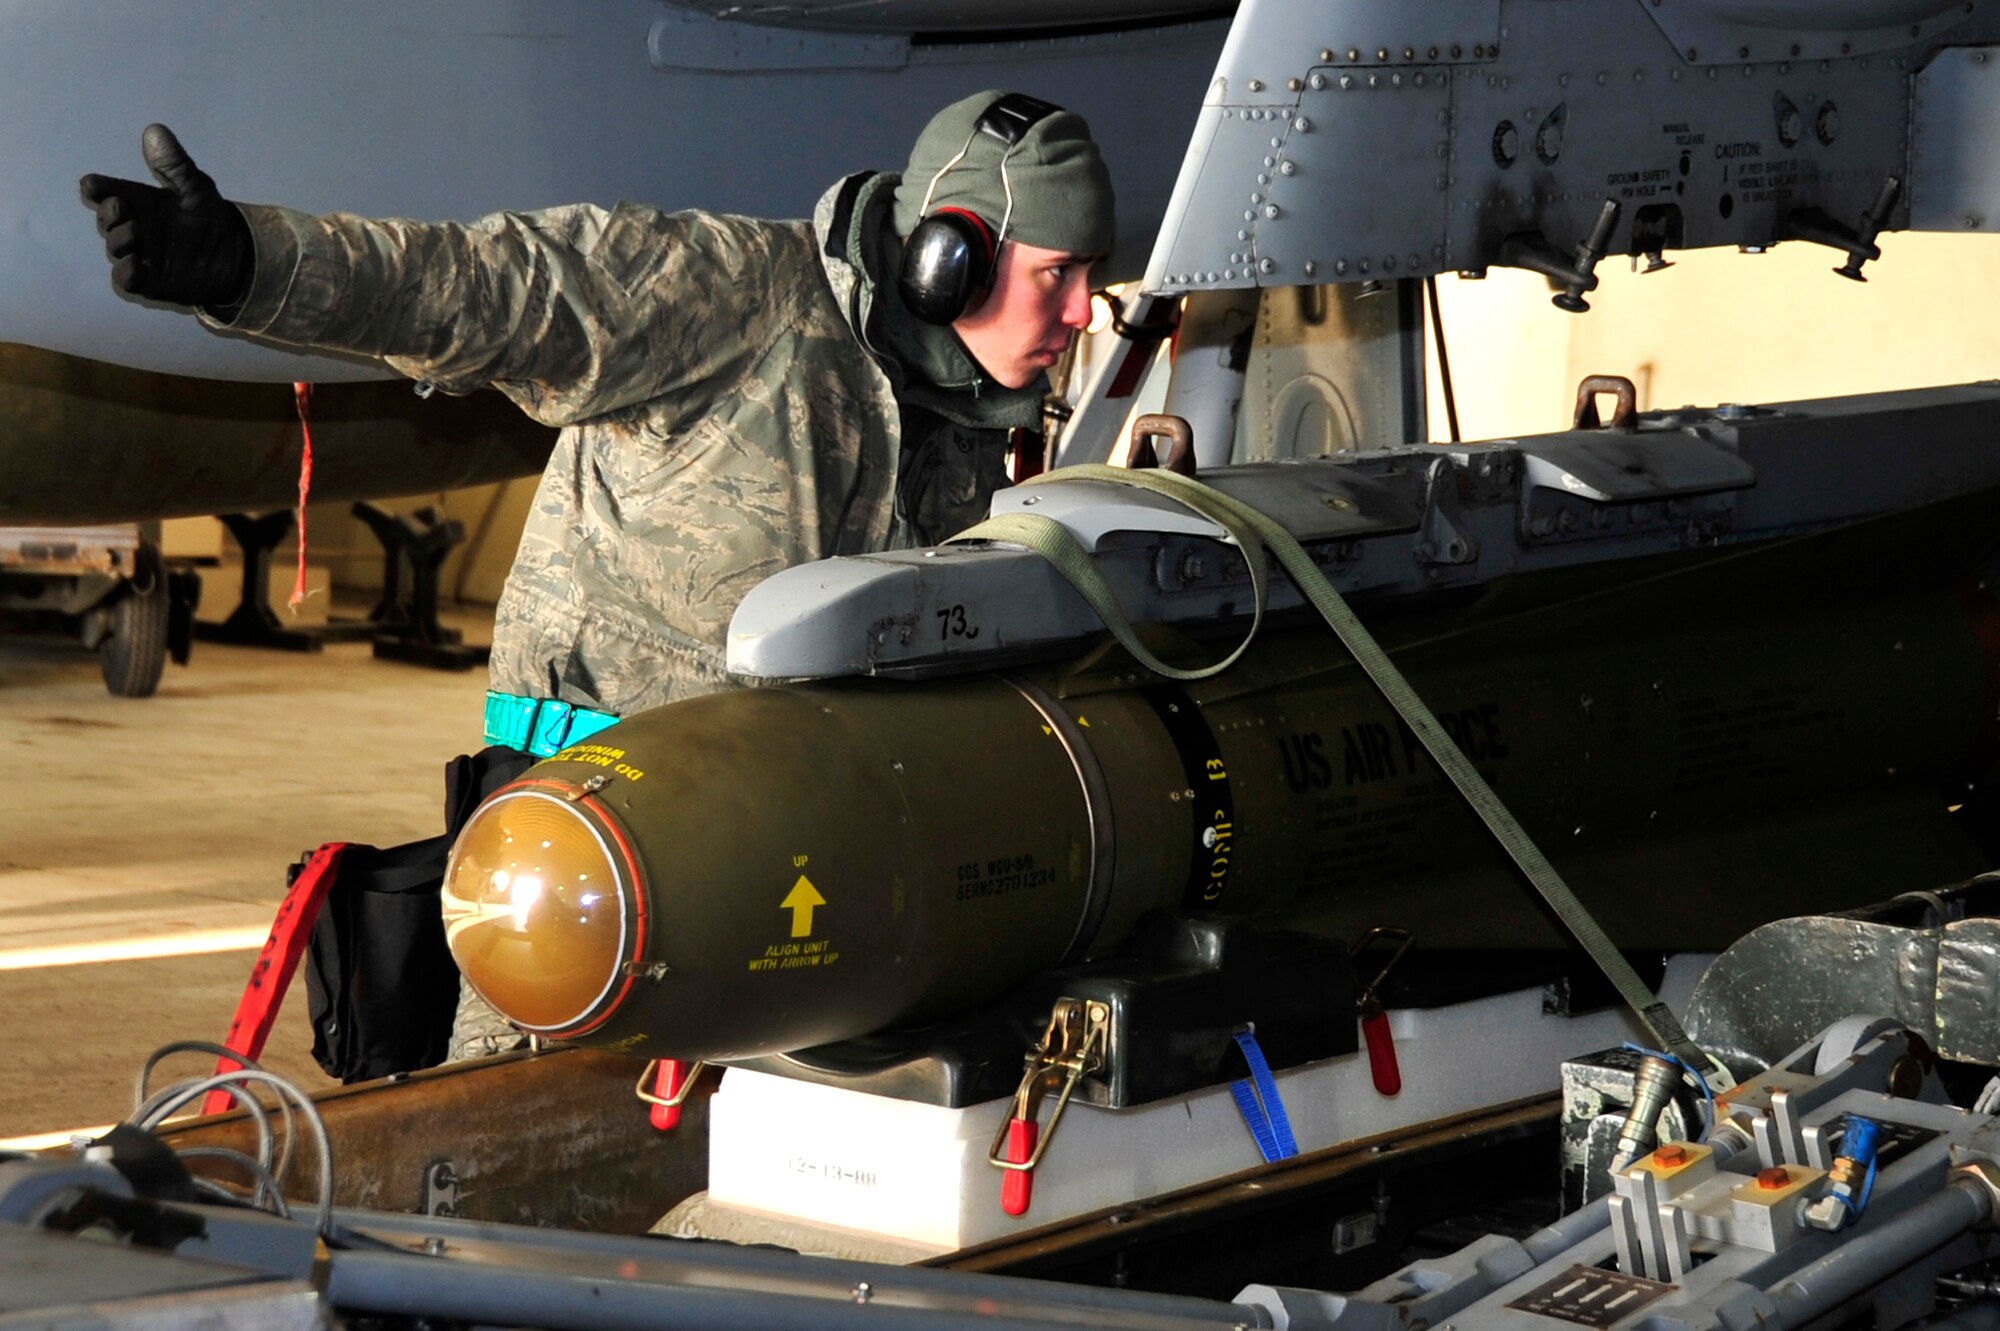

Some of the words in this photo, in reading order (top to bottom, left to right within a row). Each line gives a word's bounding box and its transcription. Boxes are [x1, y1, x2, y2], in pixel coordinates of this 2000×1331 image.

[1715, 142, 1761, 159] CAUTION:
[1607, 172, 1639, 185] GROUND
[1641, 169, 1670, 182] SAFETY
[1636, 185, 1656, 197] HOLE
[1279, 732, 1332, 793] US
[1342, 723, 1397, 785] AIR
[1397, 704, 1509, 774] FRCE
[573, 753, 614, 767] NOT
[614, 763, 645, 782] DO
[792, 854, 809, 868] UP
[958, 863, 980, 881] GCS
[764, 943, 801, 957] ALIGN
[804, 939, 830, 954] UNIT
[748, 958, 777, 971] WITH
[780, 954, 821, 969] ARROW
[823, 953, 839, 966] UP
